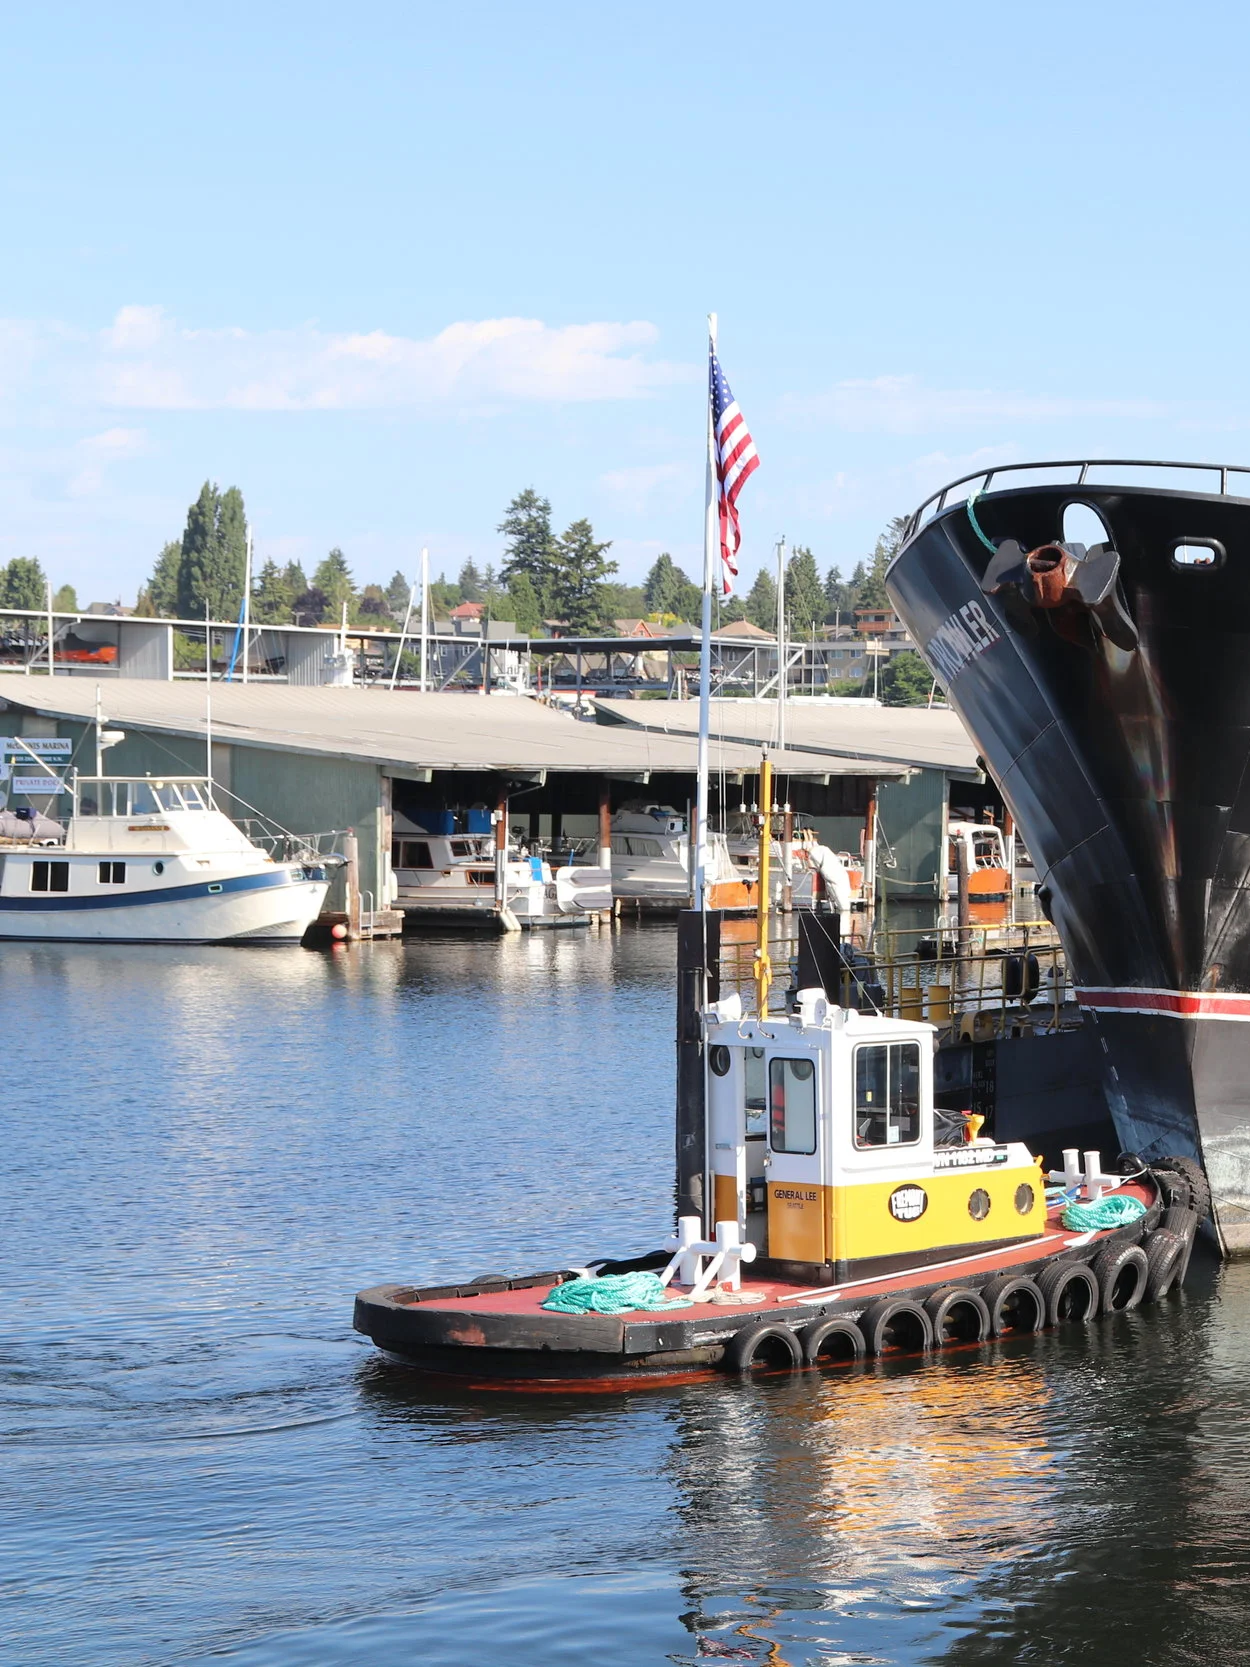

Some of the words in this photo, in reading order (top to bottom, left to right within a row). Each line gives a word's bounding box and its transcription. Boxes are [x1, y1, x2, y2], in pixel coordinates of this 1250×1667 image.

[42, 742, 69, 750] MARINA
[774, 1189, 804, 1201] GENERAL
[805, 1191, 817, 1202] LEE
